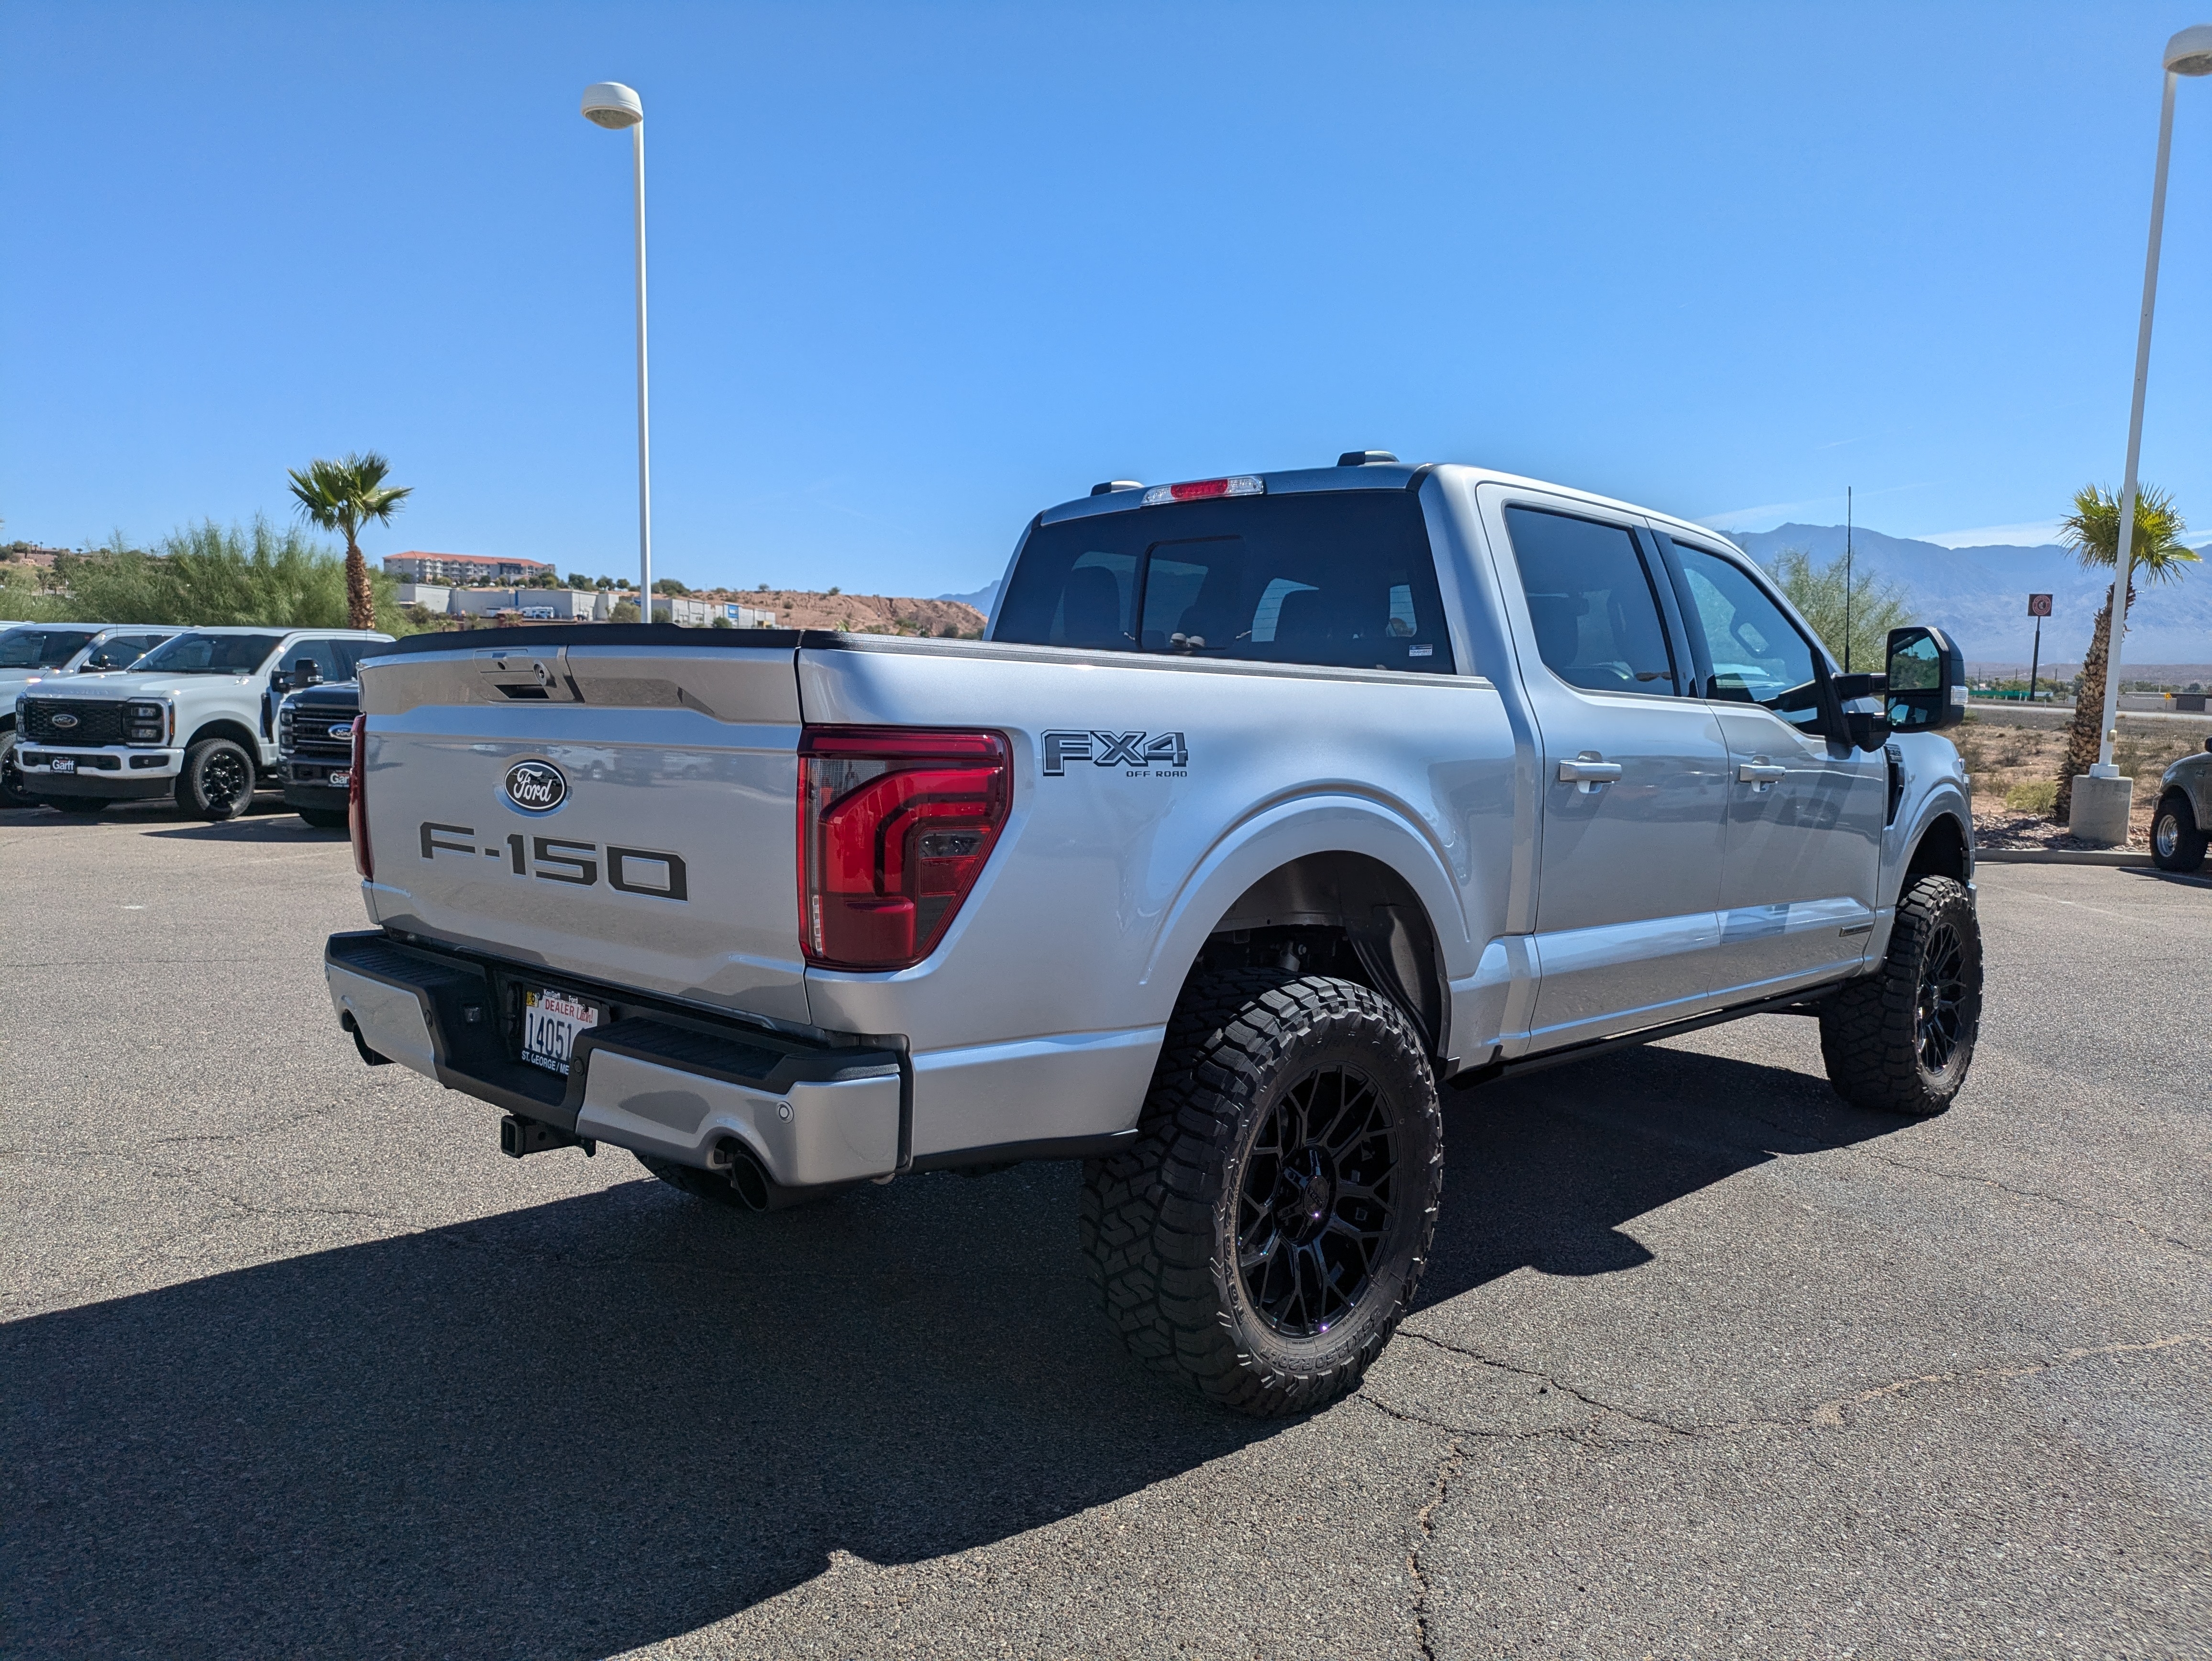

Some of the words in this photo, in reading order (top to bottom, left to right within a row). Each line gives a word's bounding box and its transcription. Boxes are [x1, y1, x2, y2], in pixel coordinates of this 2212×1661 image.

[53, 760, 74, 770] Garff
[1040, 730, 1188, 776] FX4
[513, 768, 552, 802] Ford
[420, 821, 687, 902] F-150
[545, 999, 574, 1017] DEALER
[568, 995, 578, 1004] Ford
[528, 1013, 572, 1062] 14051
[521, 1050, 530, 1062] ST.
[531, 1053, 556, 1071] GEORGE
[1225, 1234, 1245, 1324] TOYO
